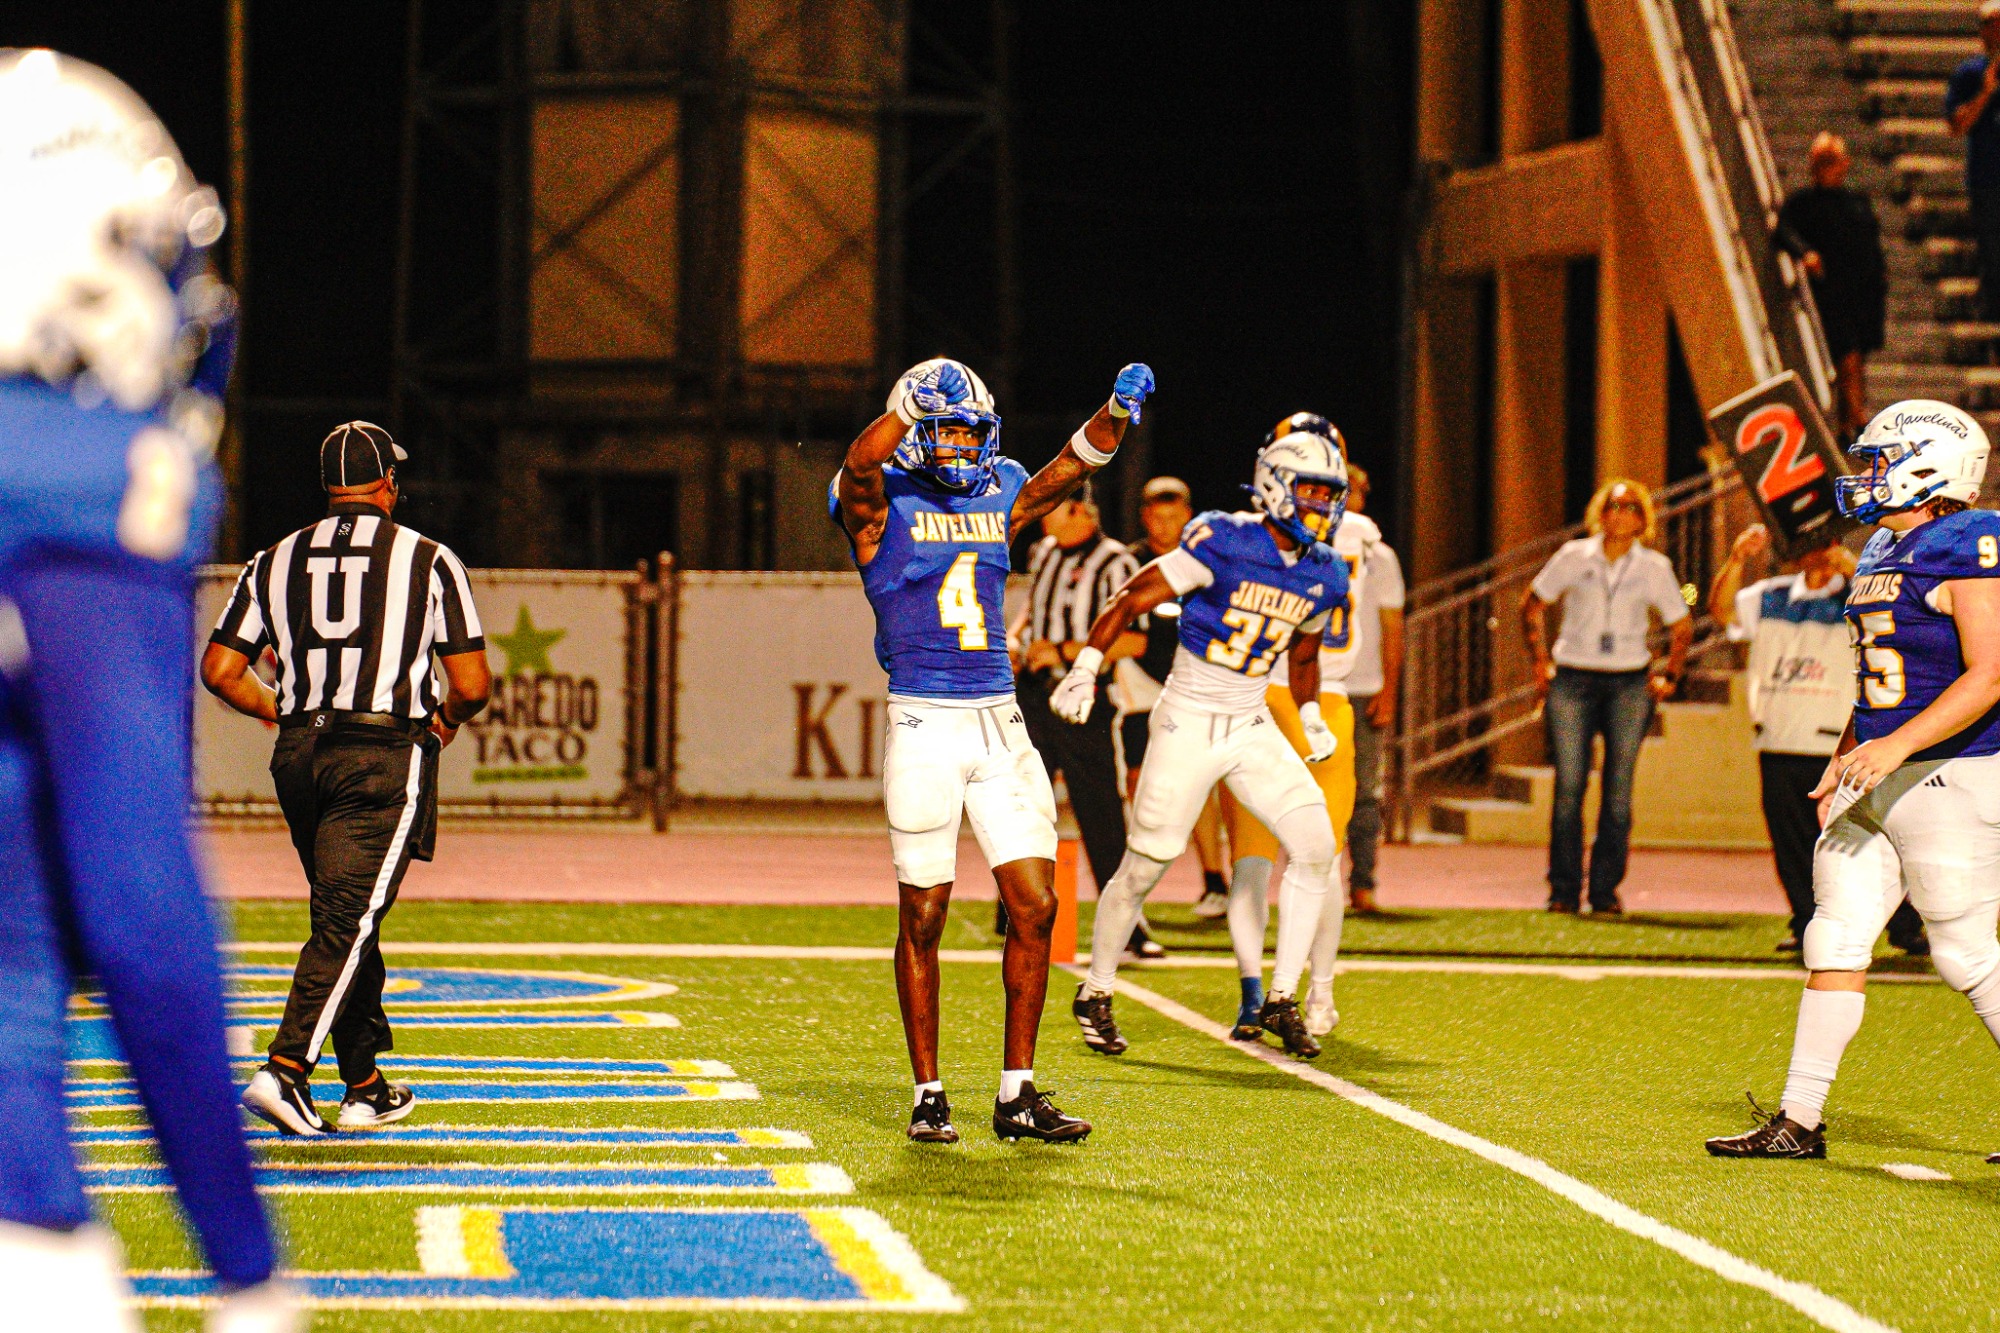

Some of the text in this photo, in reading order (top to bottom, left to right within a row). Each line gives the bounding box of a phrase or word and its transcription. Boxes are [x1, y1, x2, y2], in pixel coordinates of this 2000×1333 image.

[1883, 412, 1969, 440] Javelinas
[1736, 402, 1826, 504] 2
[910, 511, 1006, 543] JAVELINAS
[1977, 535, 2000, 569] 9
[306, 556, 370, 639] U
[937, 552, 988, 651] 4
[1229, 580, 1316, 626] JAVELINAS
[467, 674, 599, 731] AREDO
[468, 727, 588, 765] TACO
[790, 682, 887, 780] KI
